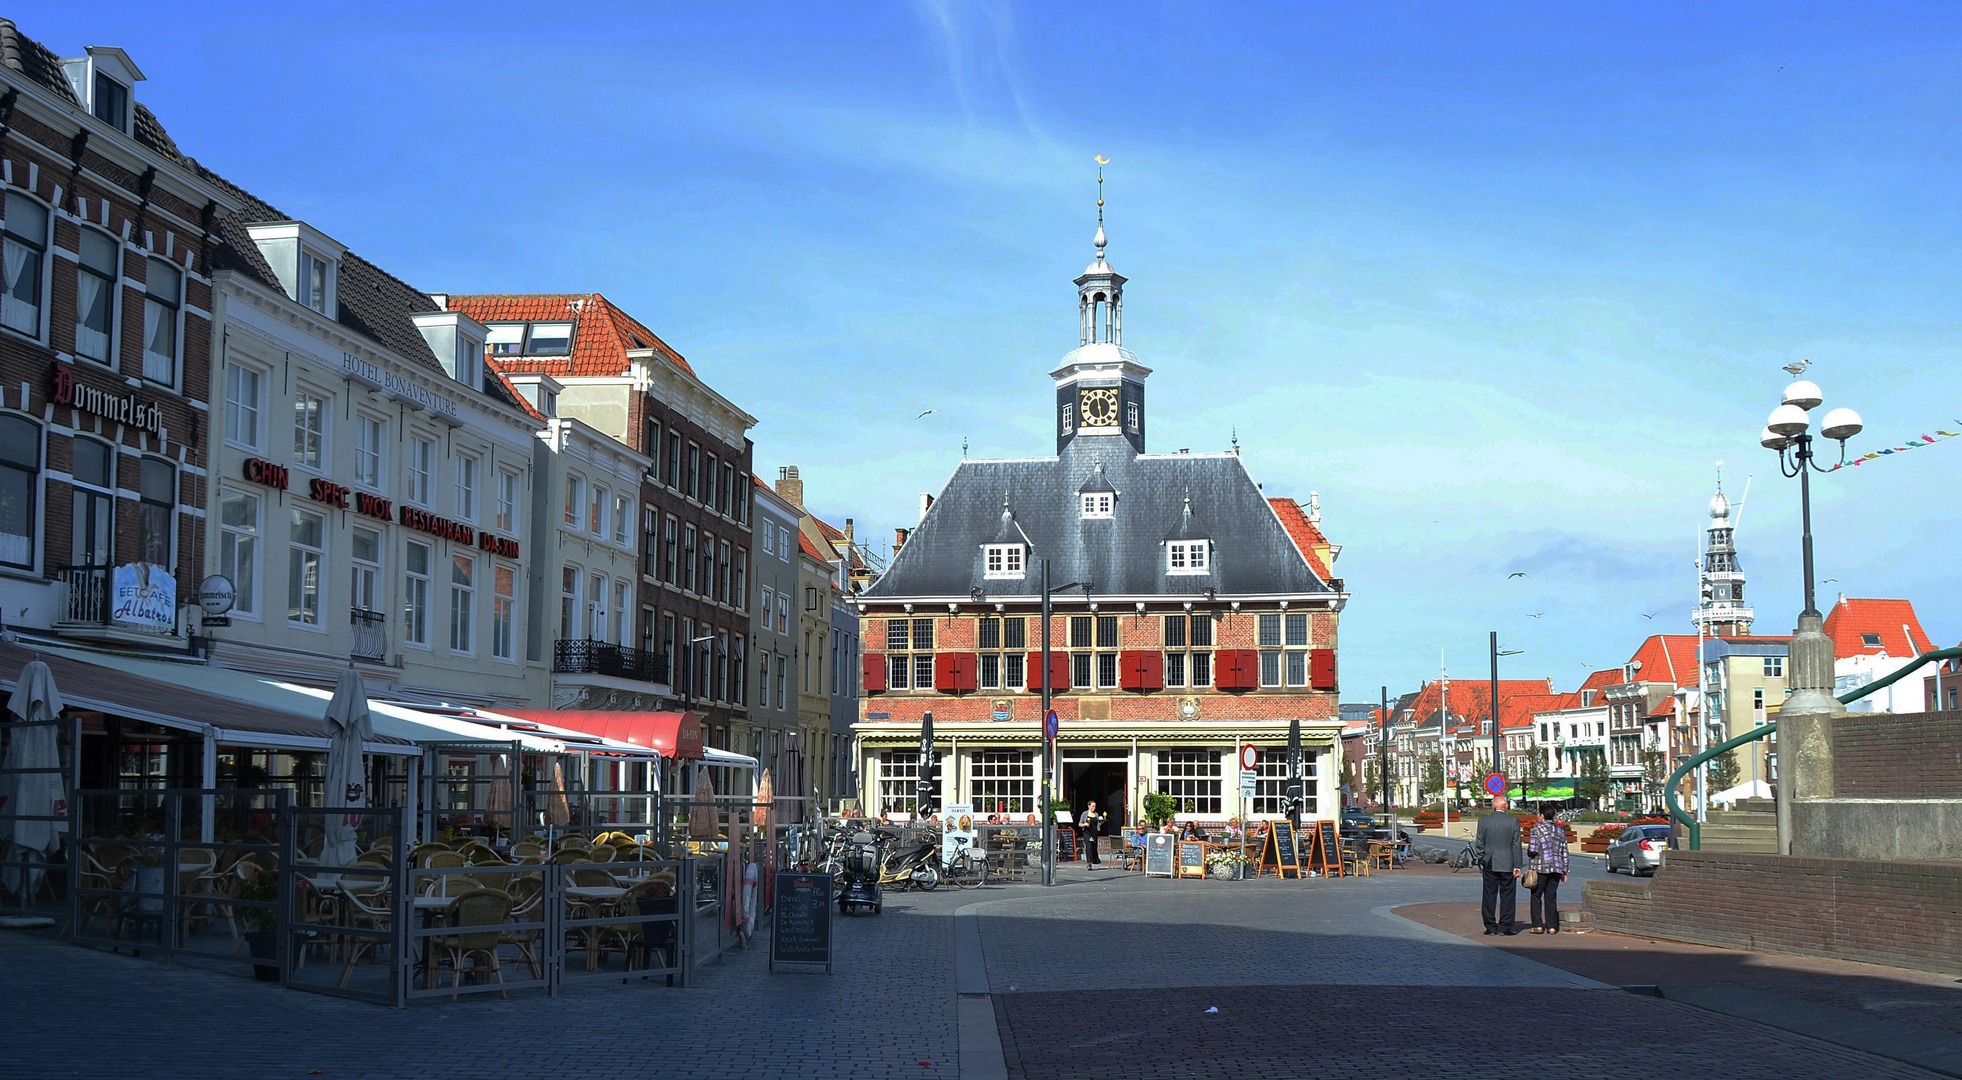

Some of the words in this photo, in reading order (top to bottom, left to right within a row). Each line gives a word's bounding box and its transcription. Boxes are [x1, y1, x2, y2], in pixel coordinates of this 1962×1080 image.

[54, 363, 163, 440] Dommelsch
[343, 352, 381, 383] HOTEL
[385, 371, 457, 416] BONAVENTURE
[246, 457, 289, 491] CHIN
[312, 478, 350, 509] SPEC
[359, 492, 393, 521] WOK
[403, 506, 475, 545] RESTAURANT
[482, 532, 519, 559] DA-XIN
[114, 599, 173, 625] Albatros
